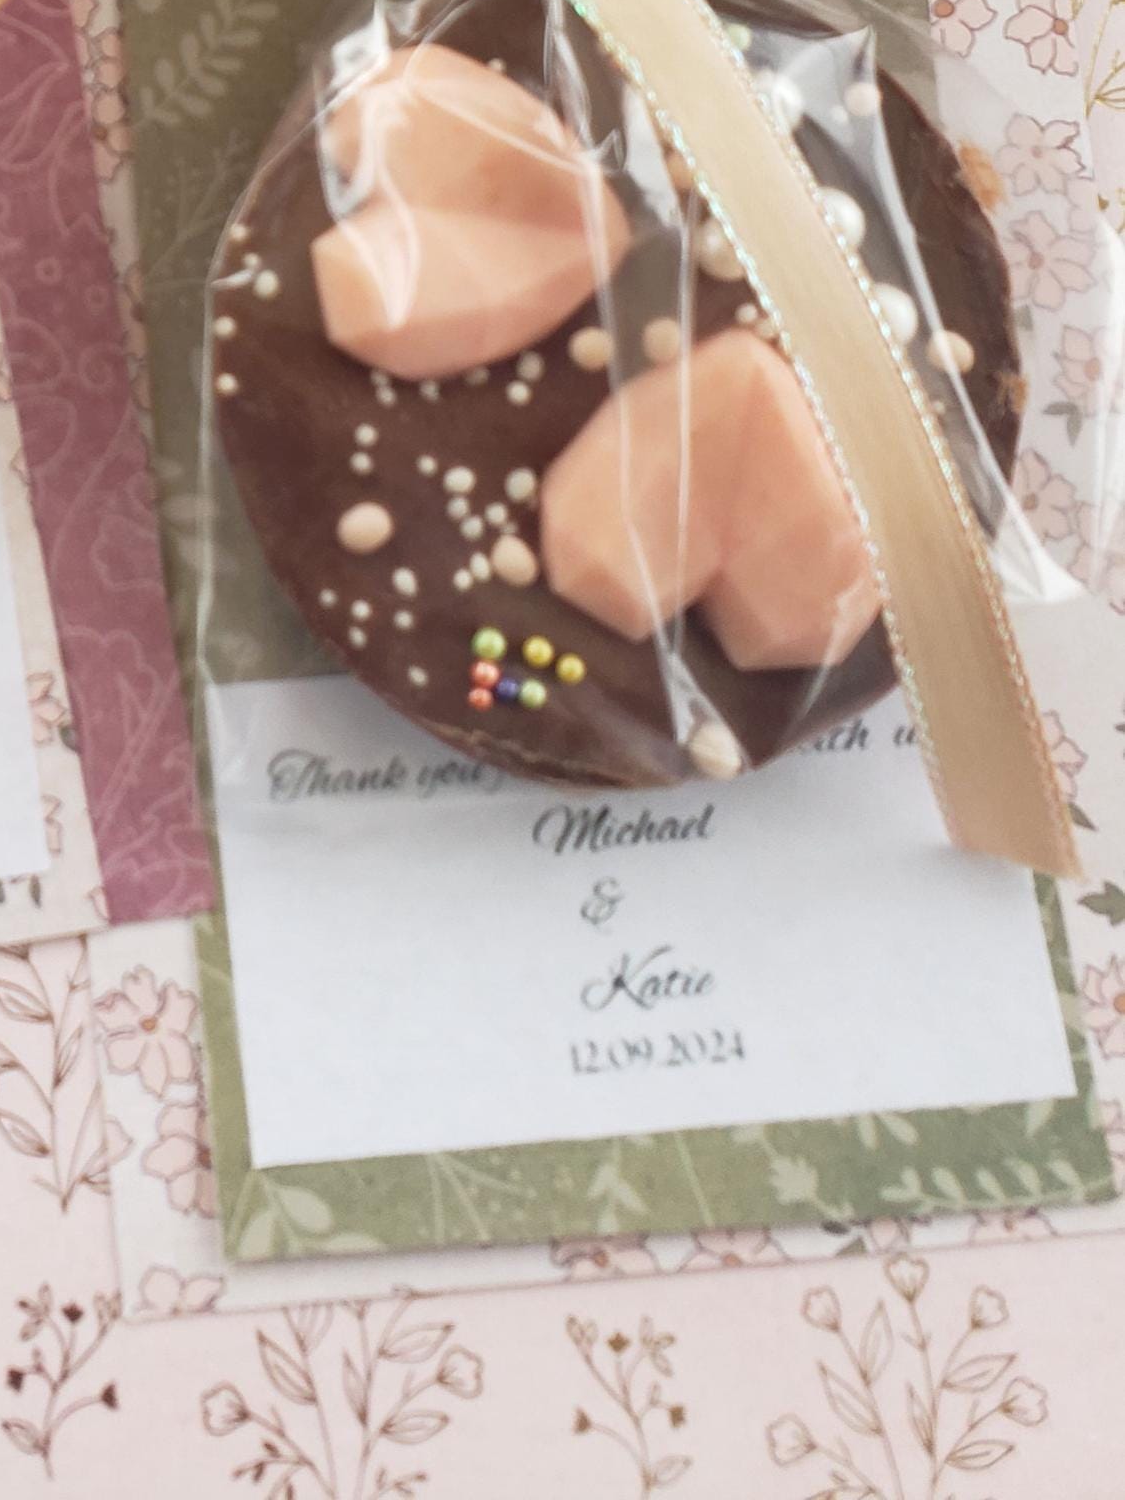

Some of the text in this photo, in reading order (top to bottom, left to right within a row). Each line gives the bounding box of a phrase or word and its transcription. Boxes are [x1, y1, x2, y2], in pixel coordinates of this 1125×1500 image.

[267, 748, 409, 803] Thank
[416, 759, 484, 799] you
[531, 803, 715, 855] Michael
[579, 875, 626, 931] &
[579, 944, 715, 1011] Katie
[569, 1029, 746, 1075] 12.09.2024
